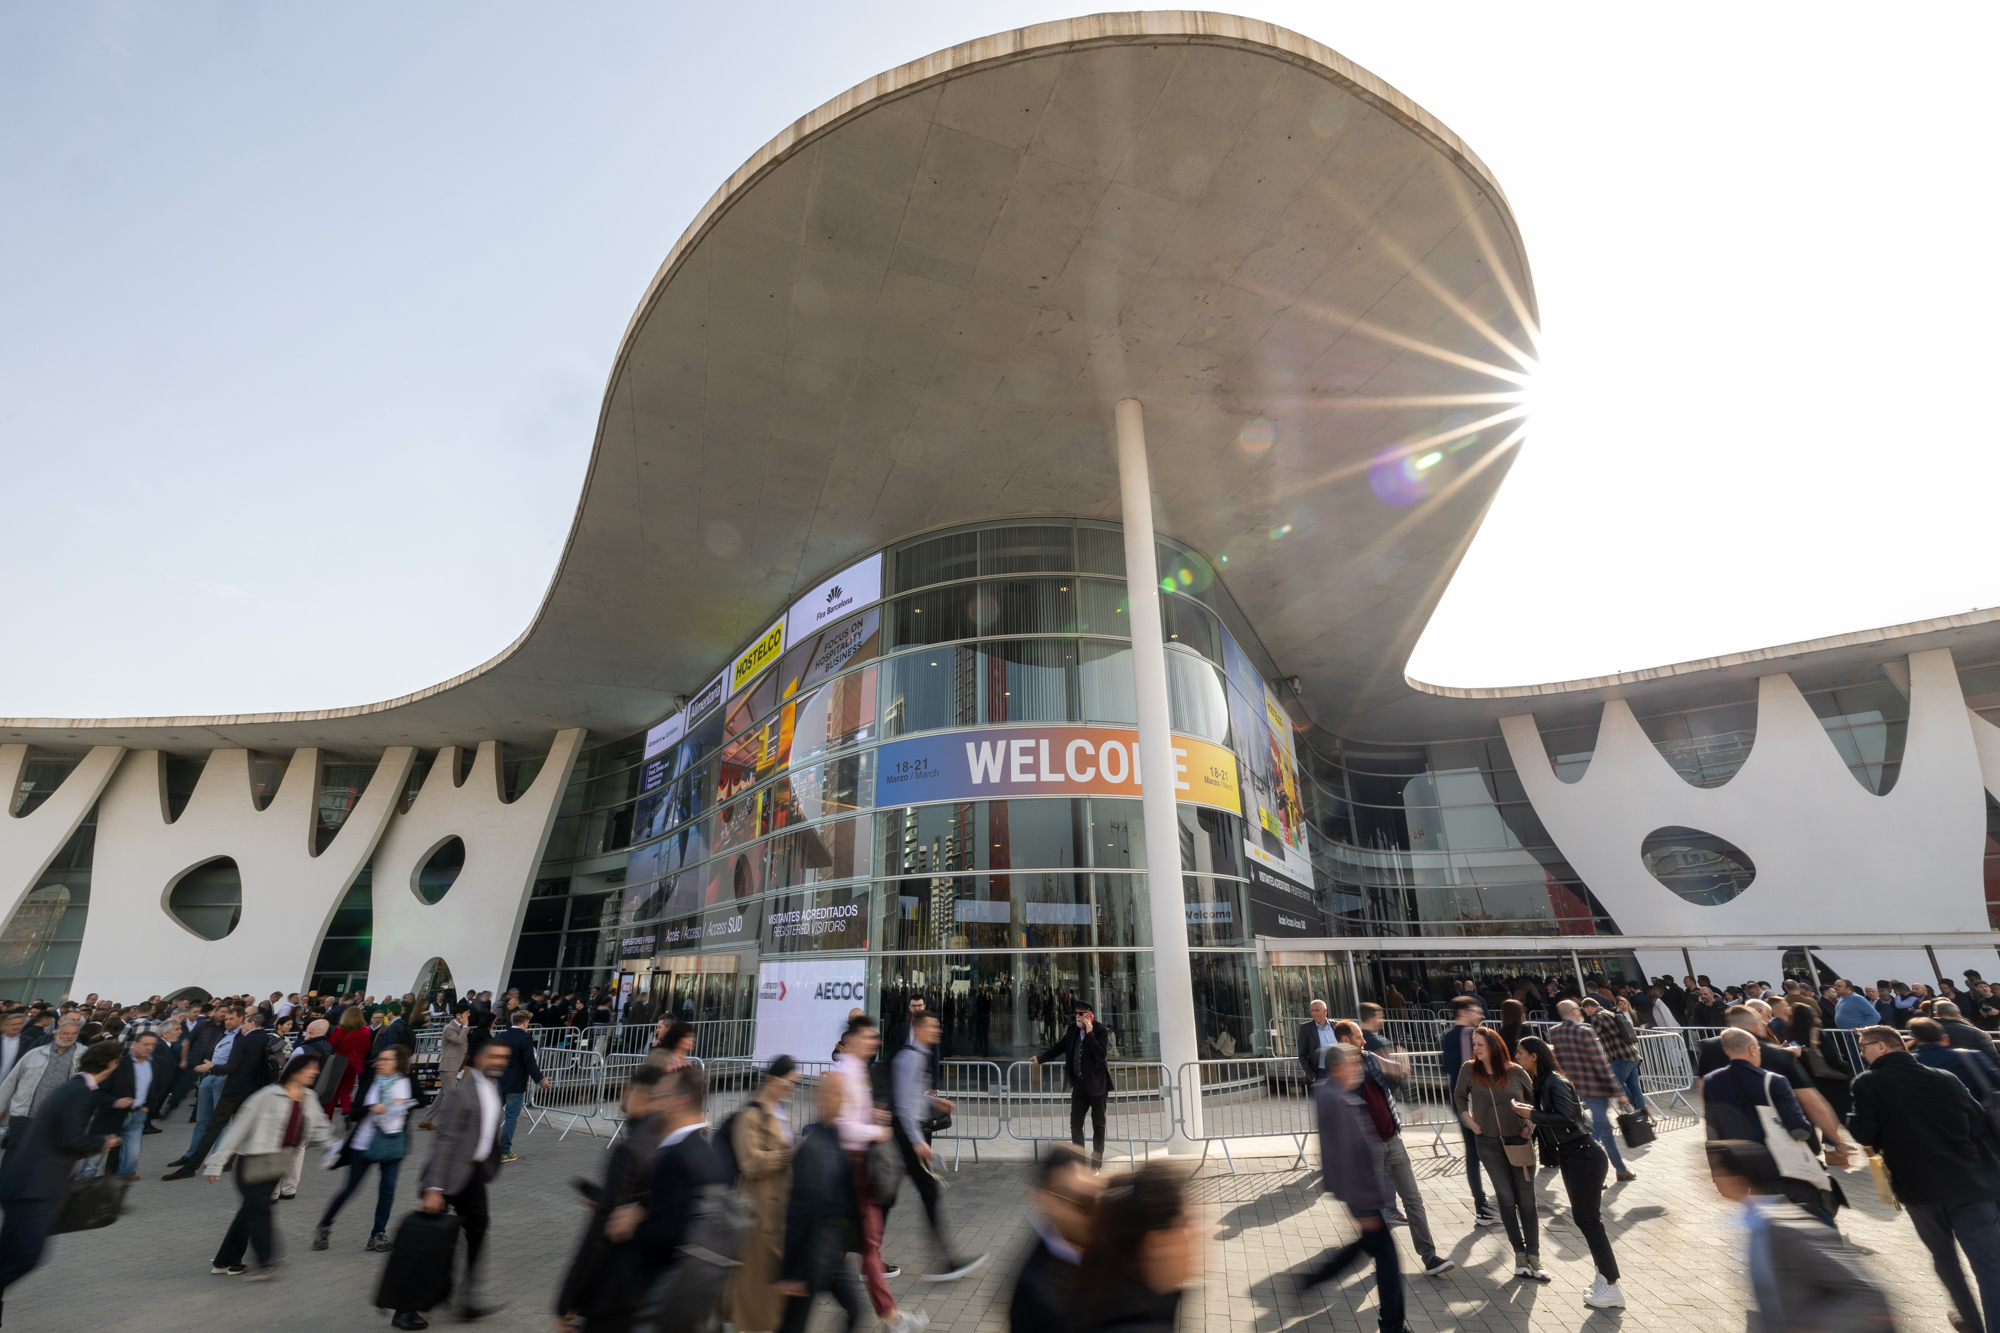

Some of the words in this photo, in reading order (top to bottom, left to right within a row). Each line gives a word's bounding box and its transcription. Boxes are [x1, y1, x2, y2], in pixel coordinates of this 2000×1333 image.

[817, 611, 826, 621] Fira
[827, 597, 853, 615] Barcelona
[824, 629, 848, 652] FOCUS
[851, 618, 863, 632] ON
[736, 628, 781, 680] HOSTELCO
[815, 629, 863, 670] HOSPITALITY
[825, 641, 862, 673] BUSINESS
[690, 684, 720, 720] Alimentaria
[887, 775, 908, 784] Marzo
[915, 769, 939, 779] March
[896, 758, 928, 773] 18-21
[966, 739, 1190, 790] WELCOE
[1210, 766, 1228, 781] 18-21
[1204, 776, 1219, 786] Marzo
[768, 910, 800, 925] VISITANTES
[801, 905, 858, 921] ACREDITADOS
[666, 928, 680, 942] Accés
[684, 926, 702, 939] Acceso
[707, 921, 727, 936] Access
[728, 916, 742, 933] SUD
[773, 923, 810, 937] REGISTERED
[811, 920, 846, 934] VISITORS
[814, 982, 863, 1000] AECOC
